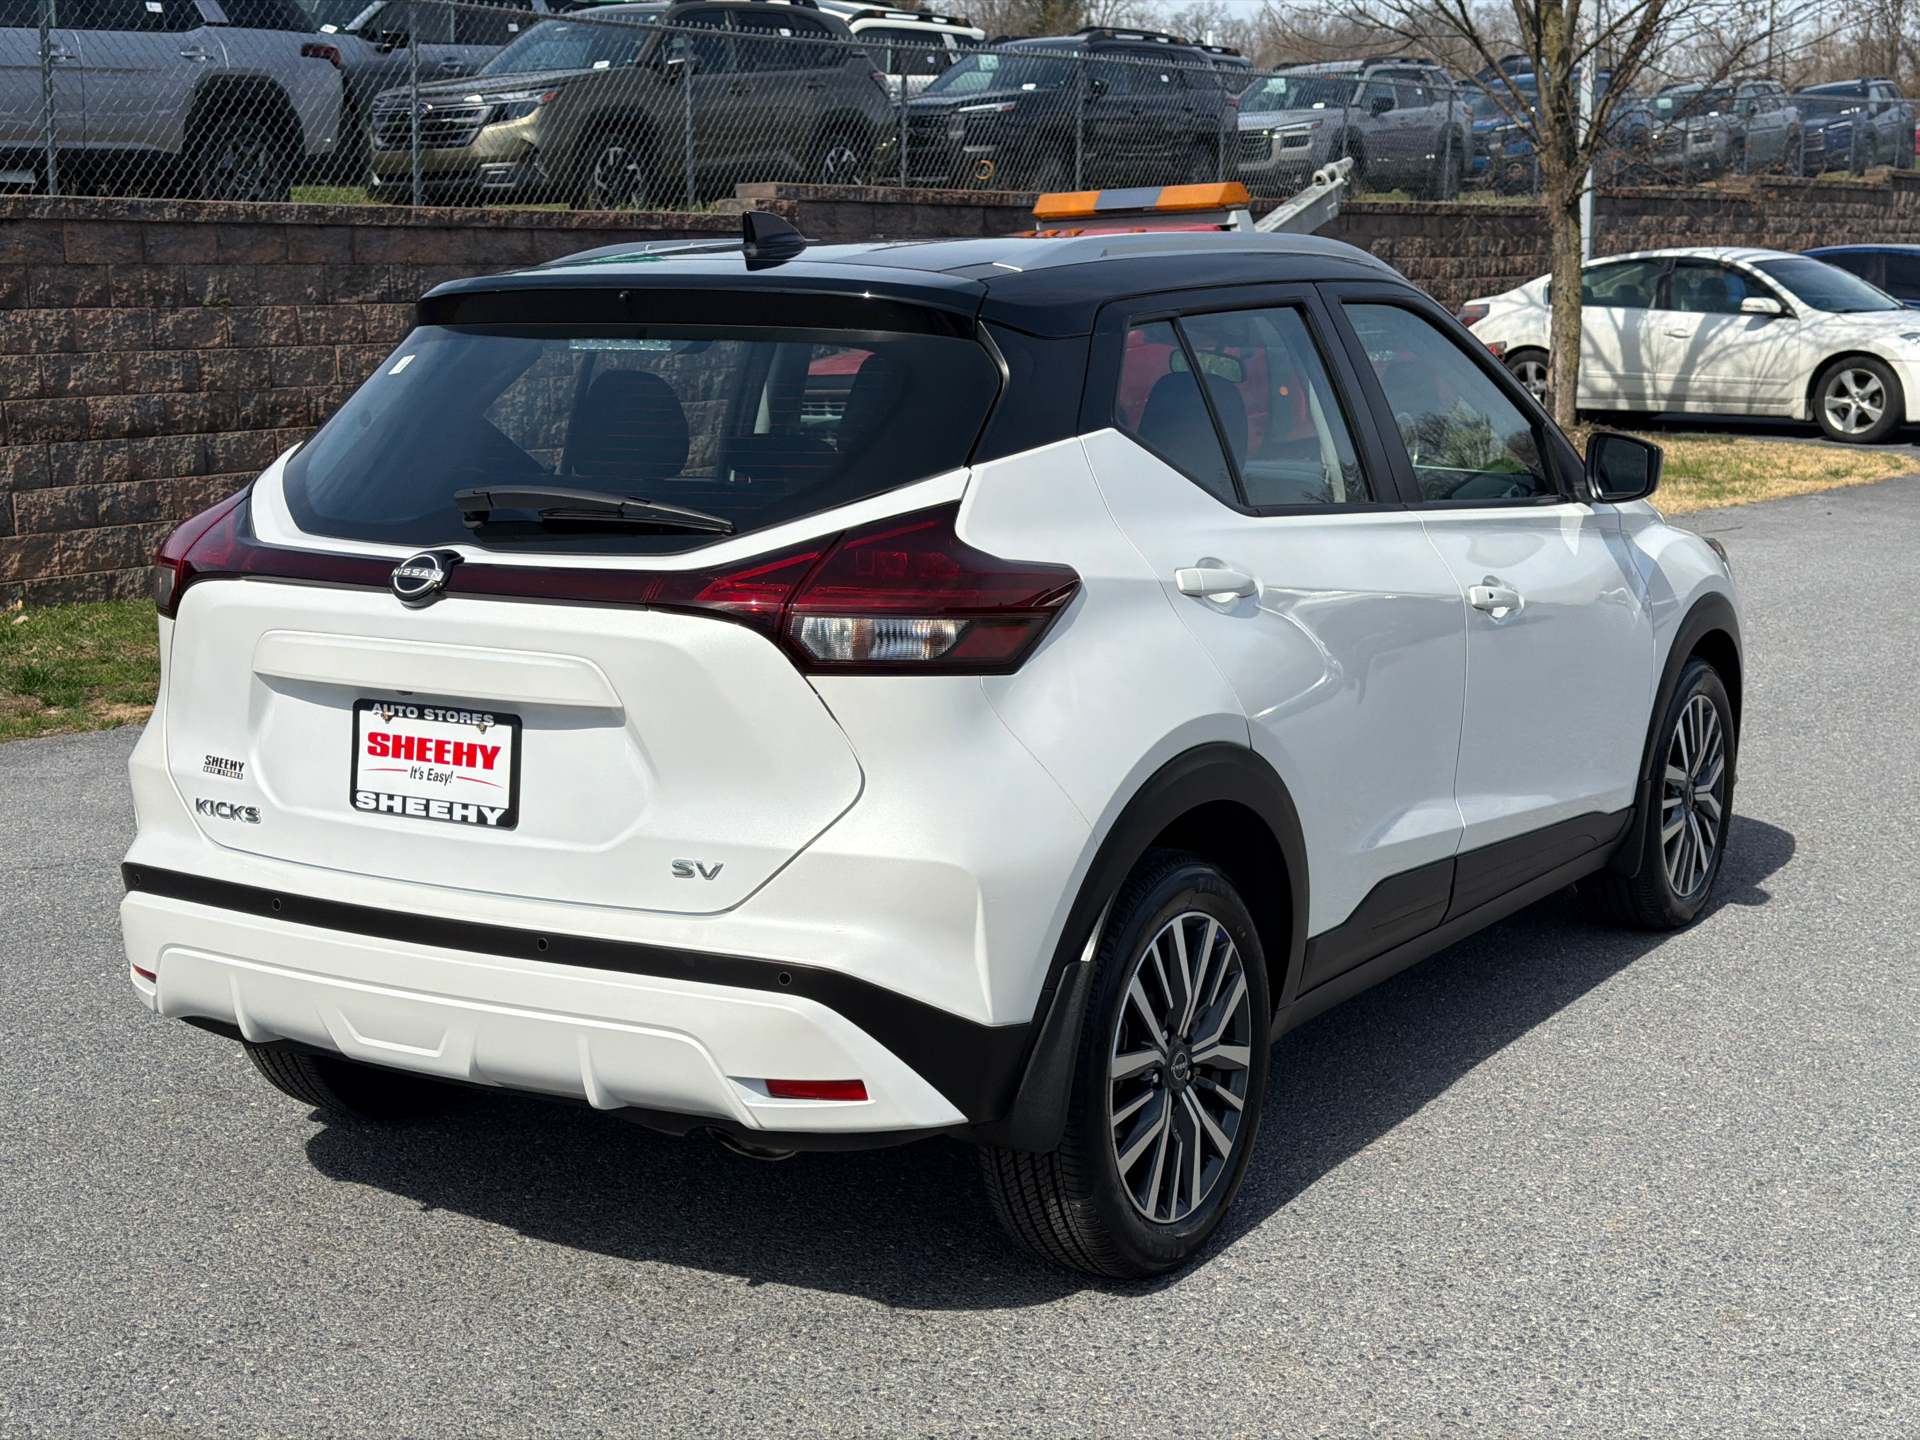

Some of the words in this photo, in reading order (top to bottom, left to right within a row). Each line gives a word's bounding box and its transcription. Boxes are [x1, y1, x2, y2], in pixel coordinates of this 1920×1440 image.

[392, 568, 441, 579] NISSAN
[372, 703, 418, 718] AUTO
[424, 709, 495, 726] STORES
[367, 732, 501, 770] SHEEHY
[205, 755, 245, 772] SHEEHY
[410, 766, 424, 780] It's
[427, 768, 454, 786] Easy!
[195, 797, 261, 824] KICKS
[355, 792, 505, 825] SHEEHY
[671, 859, 724, 881] SV
